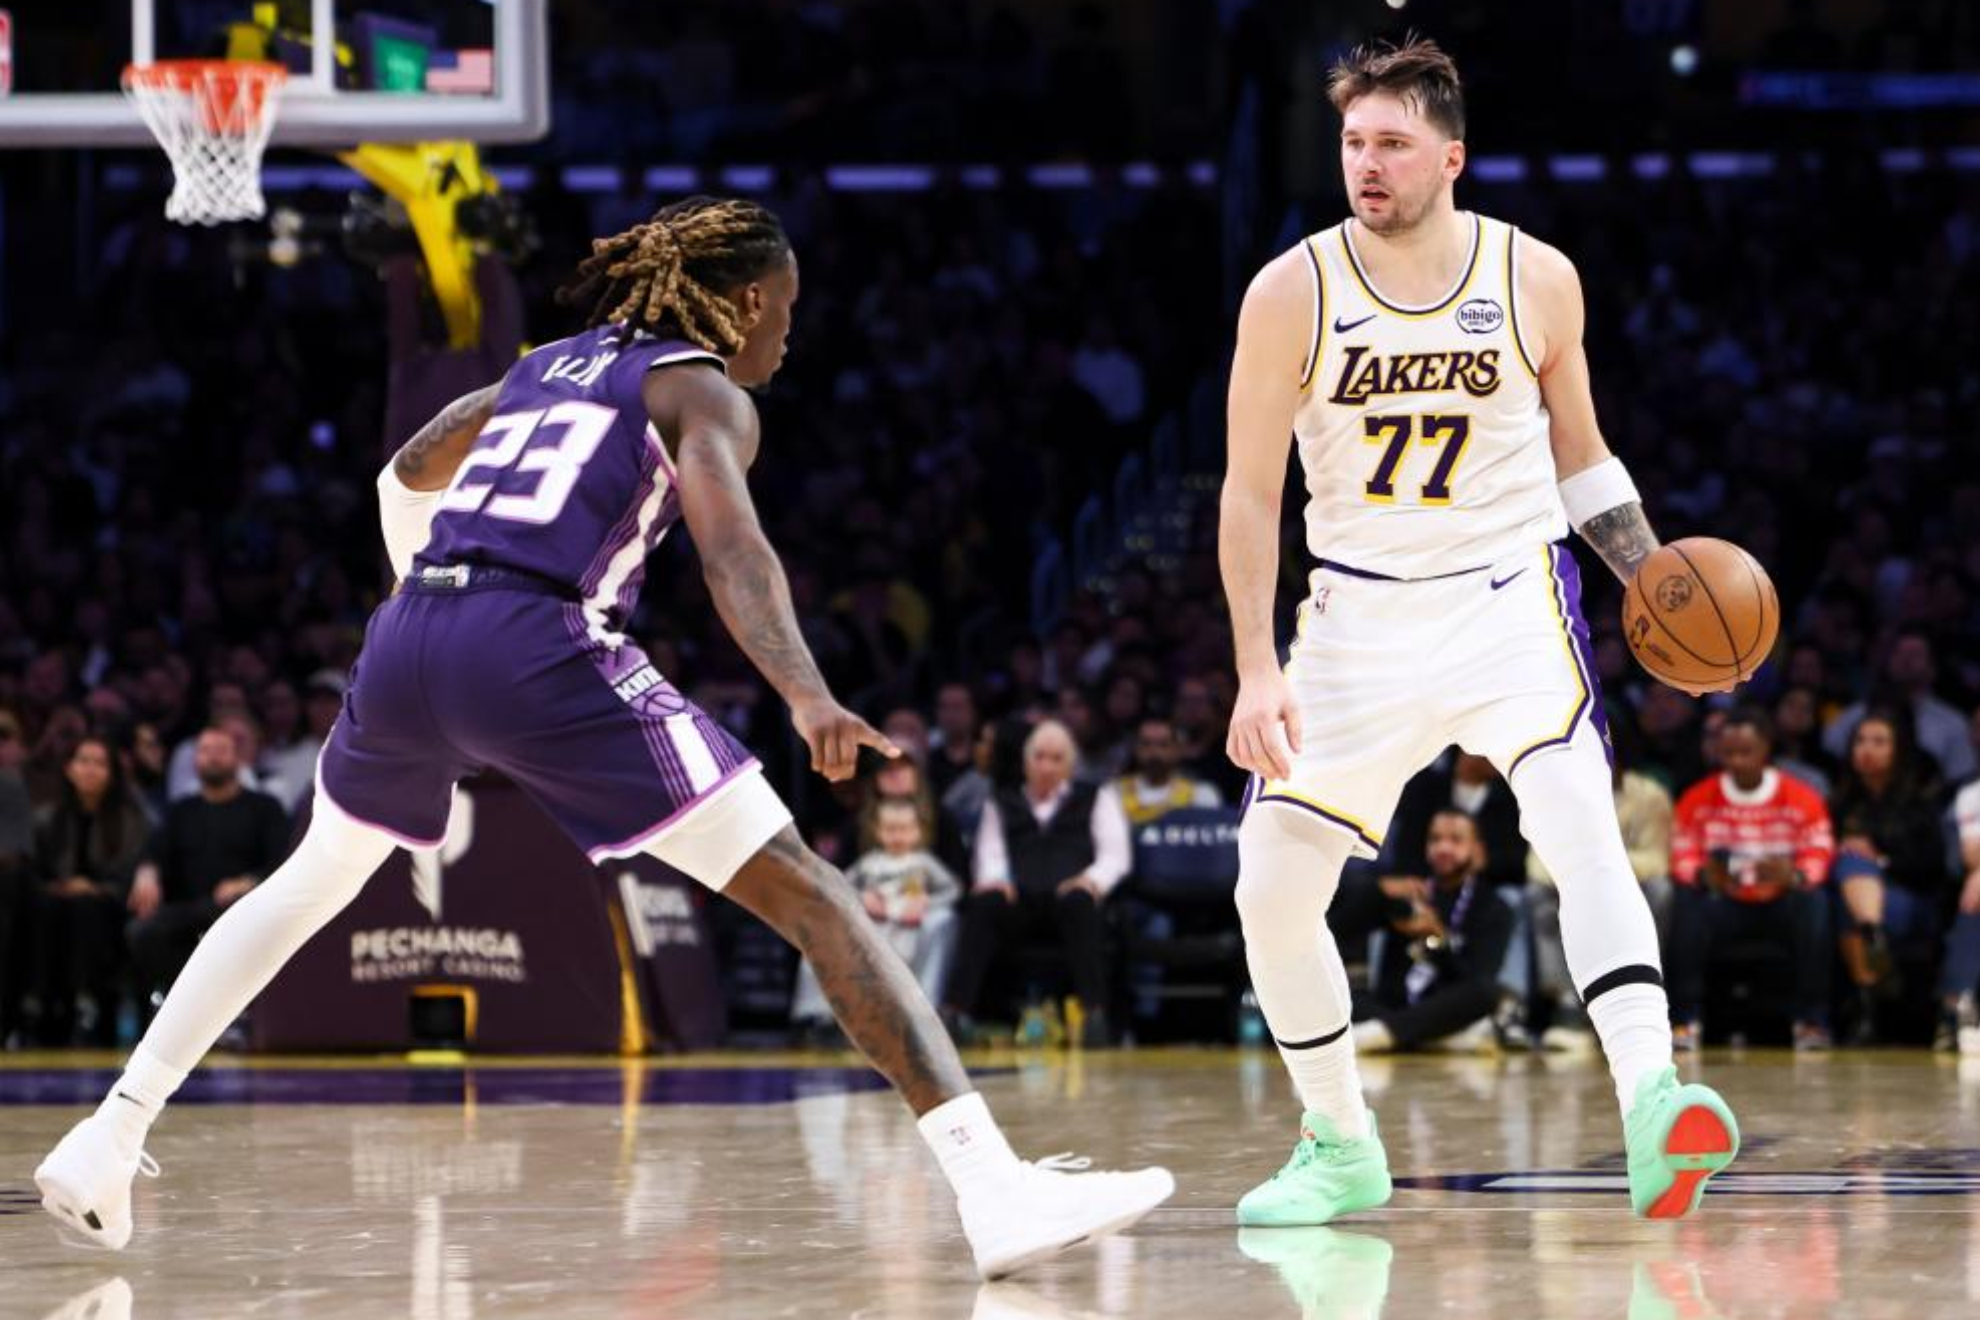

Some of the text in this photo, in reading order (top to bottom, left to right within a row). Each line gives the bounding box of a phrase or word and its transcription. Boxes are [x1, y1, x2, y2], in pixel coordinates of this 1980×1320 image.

[1460, 308, 1500, 323] bibigo
[1329, 346, 1499, 405] LAKERS
[440, 401, 619, 524] 23
[1364, 414, 1470, 505] 77
[351, 928, 524, 960] PECHANGA
